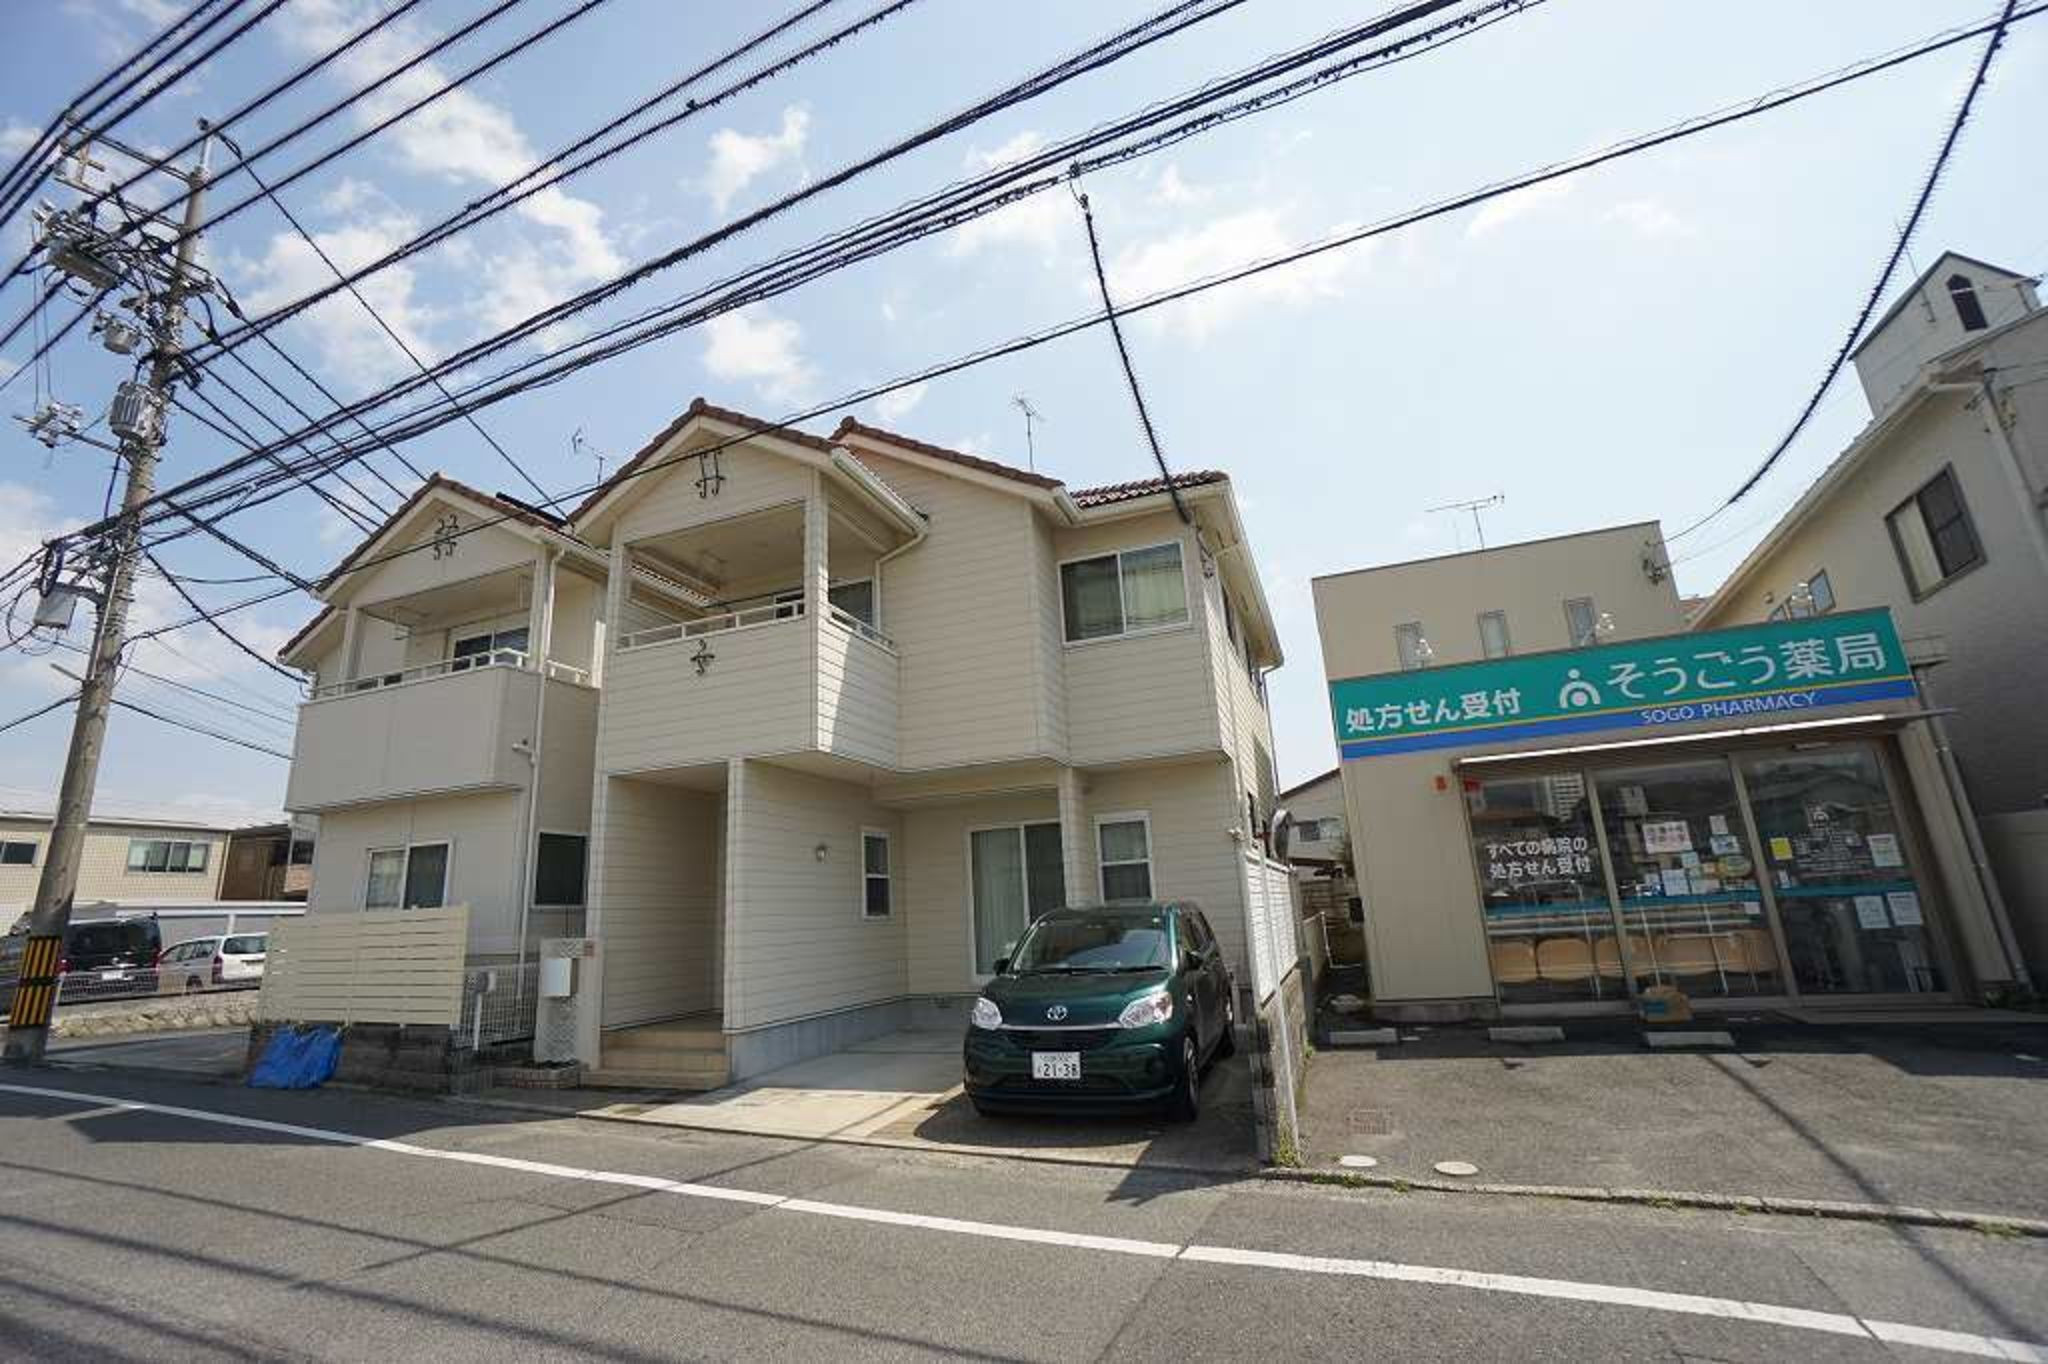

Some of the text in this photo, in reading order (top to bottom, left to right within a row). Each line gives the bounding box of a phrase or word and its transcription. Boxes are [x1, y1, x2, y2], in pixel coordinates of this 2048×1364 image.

[1607, 632, 1887, 699] そうごう薬局
[1345, 688, 1521, 733] 処方せん受付
[1641, 691, 1818, 724] SOGO PHARMACY
[1485, 837, 1588, 859] すべての病院の
[1490, 856, 1591, 880] 処方せん受付
